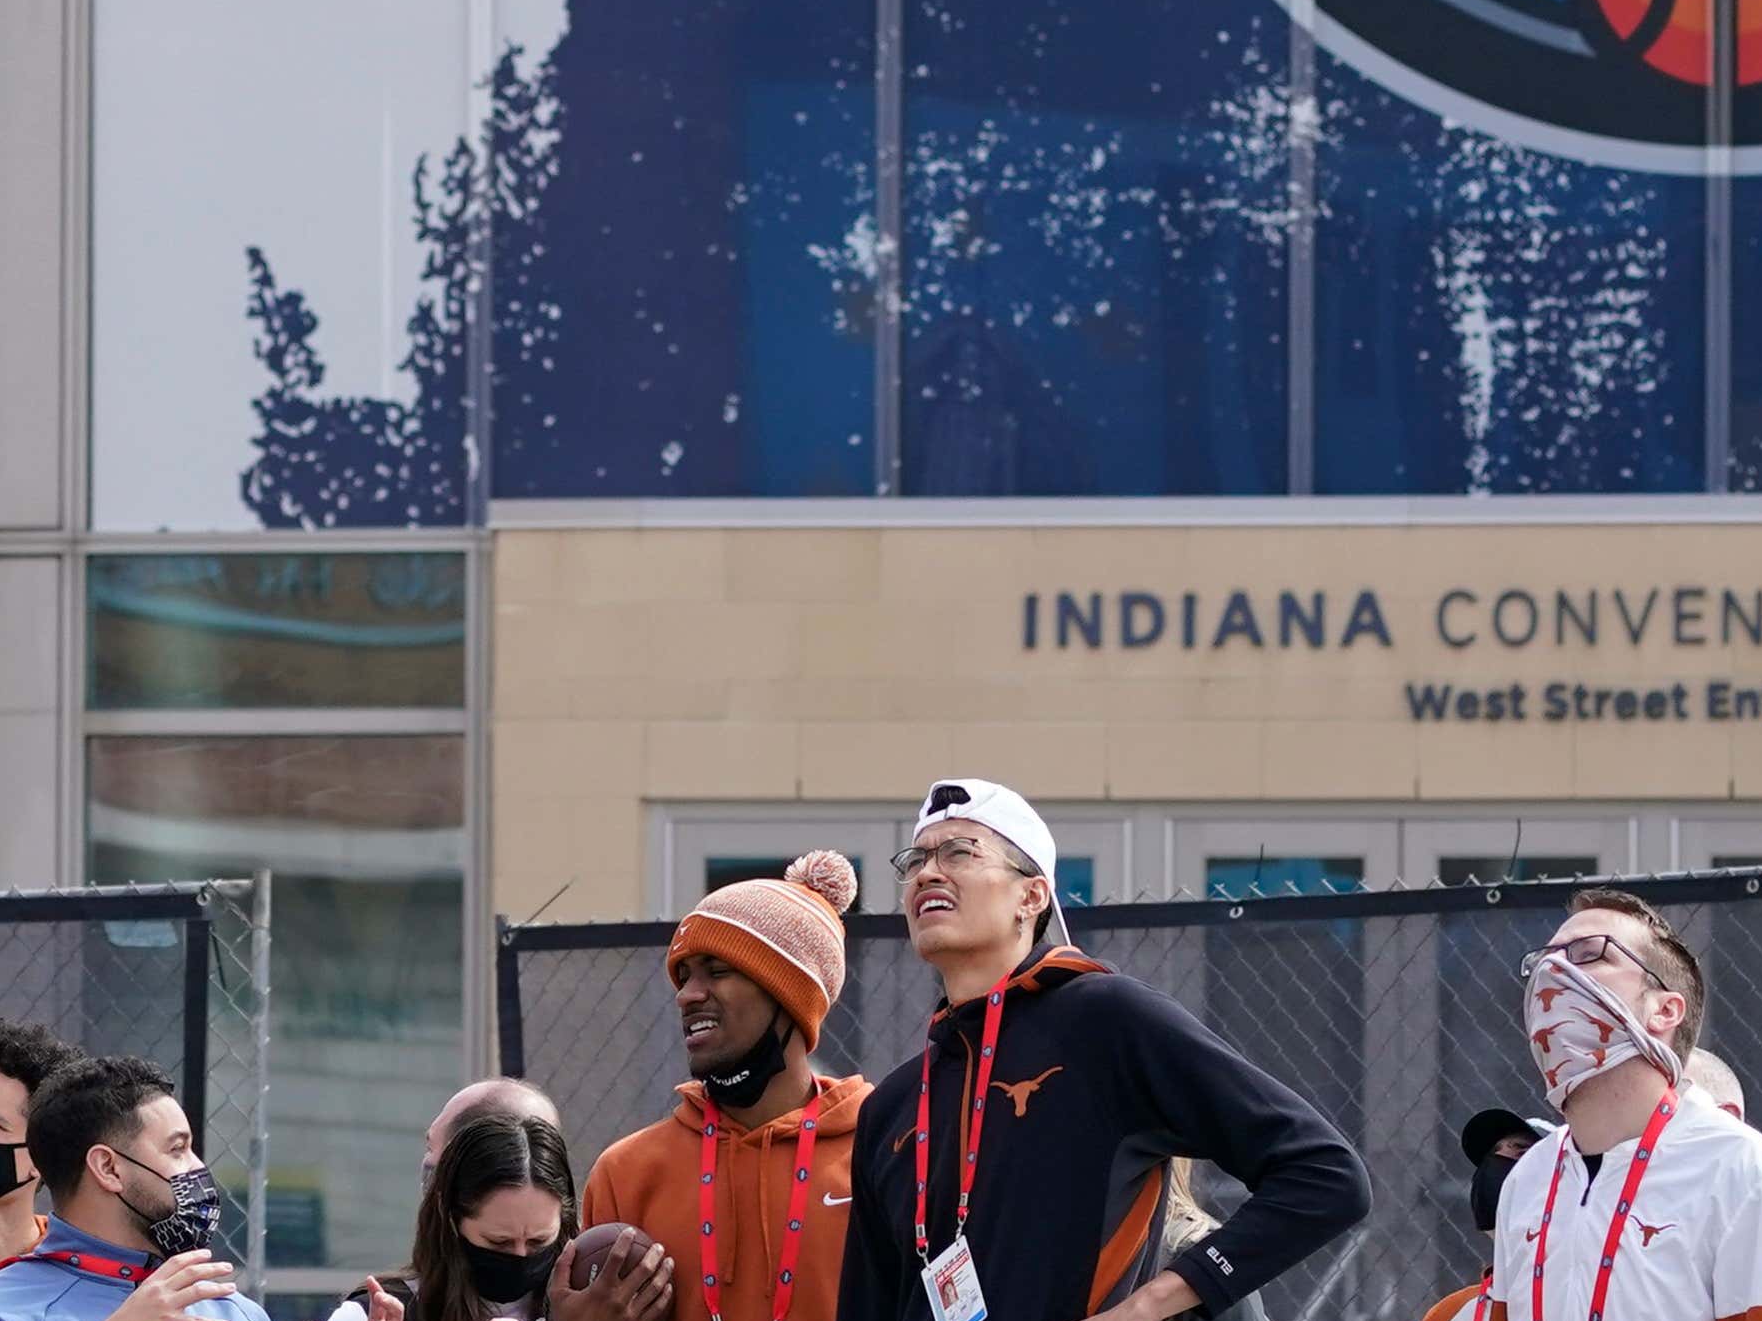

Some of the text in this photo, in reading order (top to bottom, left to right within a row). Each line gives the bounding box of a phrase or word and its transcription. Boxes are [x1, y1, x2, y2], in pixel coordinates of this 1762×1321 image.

[1022, 590, 1393, 651] INDIANA
[1404, 682, 1529, 723] West
[1543, 681, 1691, 723] Street
